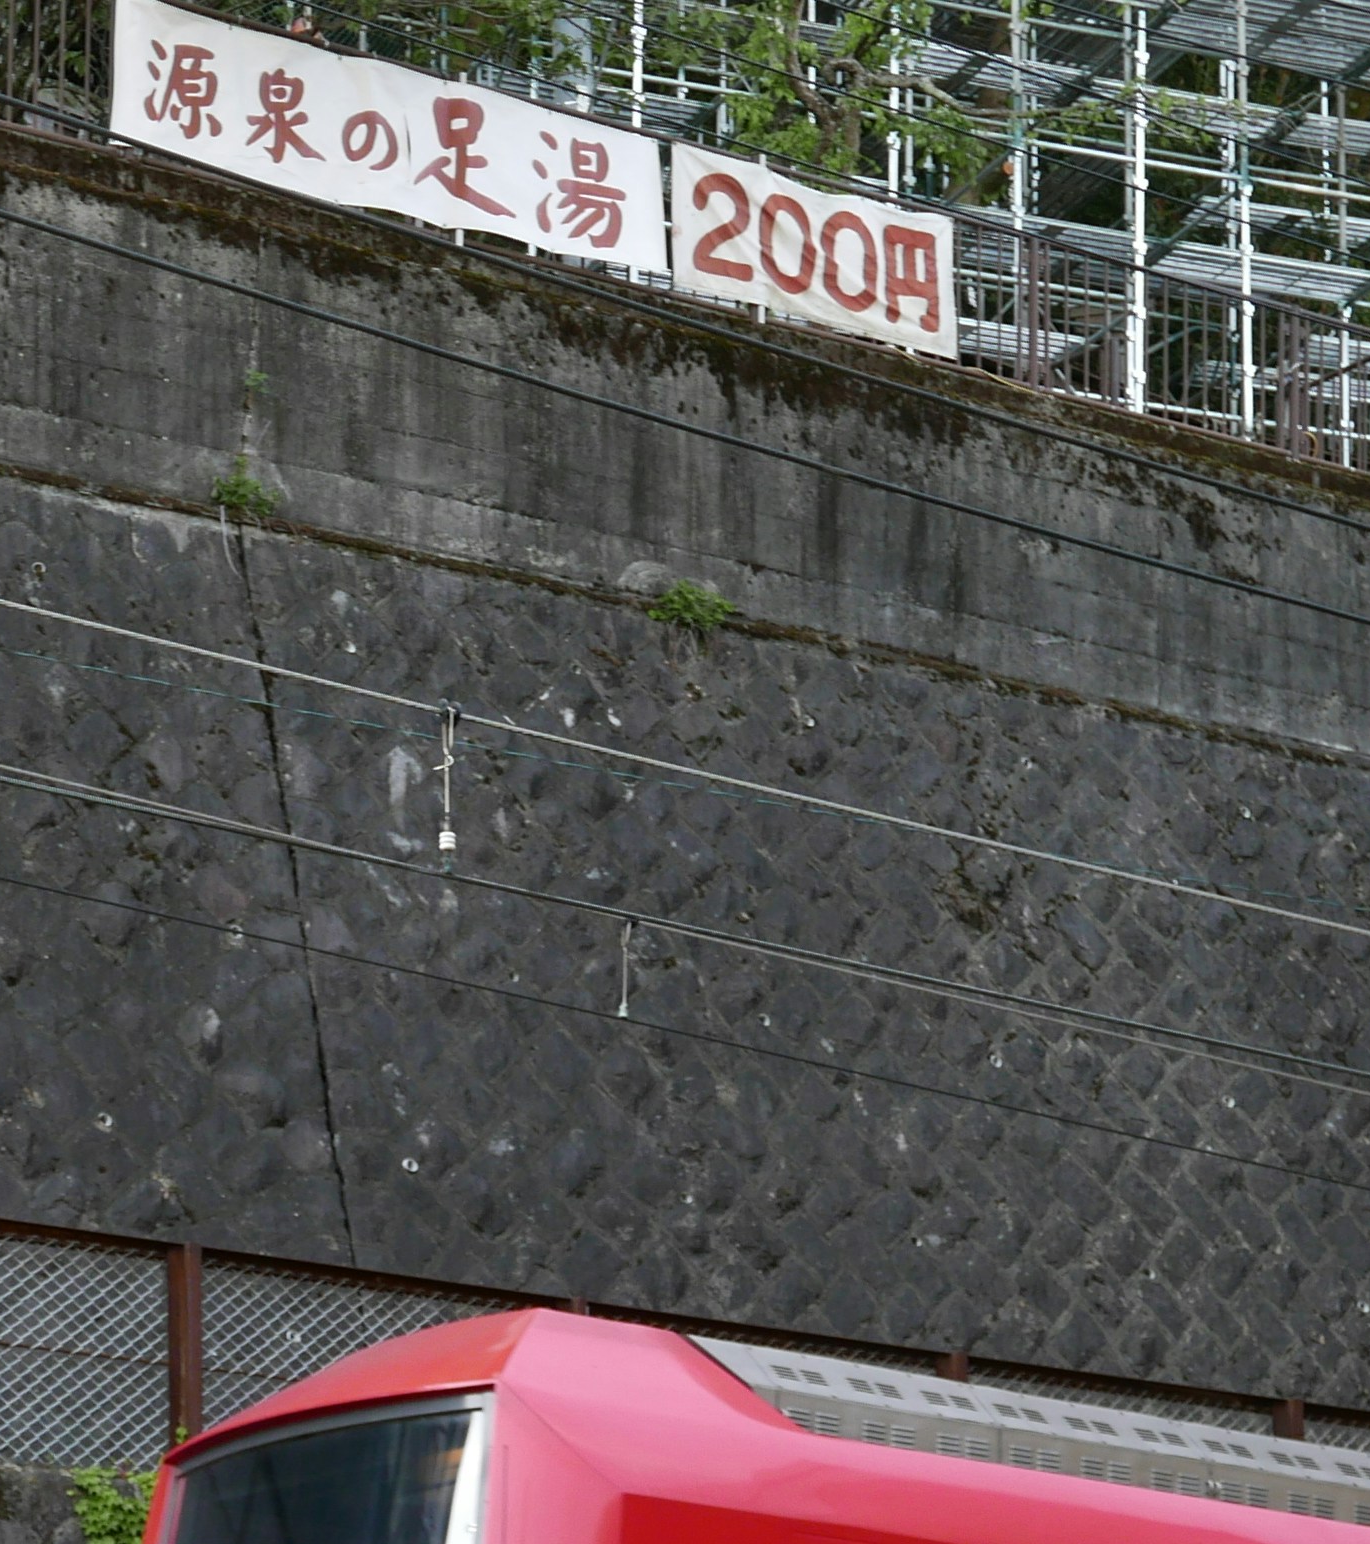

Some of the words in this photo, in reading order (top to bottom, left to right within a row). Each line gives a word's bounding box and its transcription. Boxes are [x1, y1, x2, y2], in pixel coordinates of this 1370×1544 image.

[144, 39, 627, 249] 源泉の足湯
[692, 172, 940, 333] 200円
